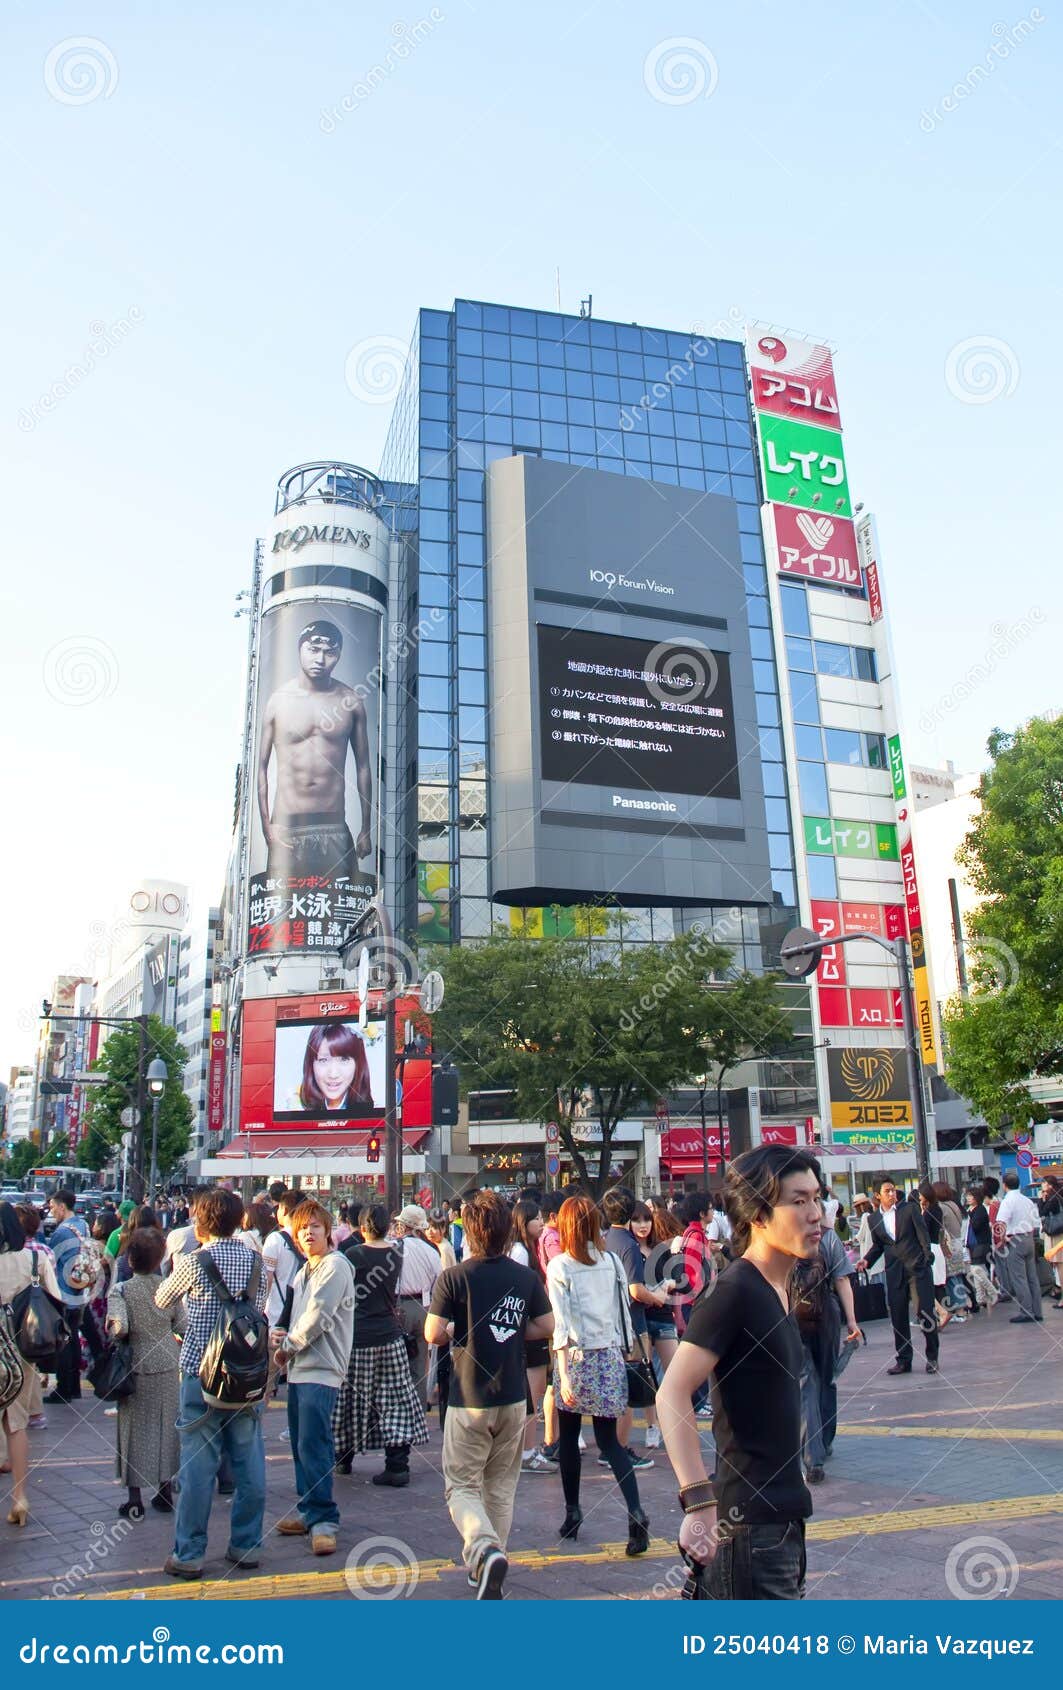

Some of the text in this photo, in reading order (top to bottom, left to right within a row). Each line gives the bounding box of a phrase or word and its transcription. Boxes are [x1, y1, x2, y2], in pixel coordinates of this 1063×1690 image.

[761, 374, 838, 413] アコム
[766, 440, 844, 485] レイク
[780, 546, 857, 581] アイフル
[589, 569, 674, 594] 109 Forum Vision
[891, 745, 904, 784] レイク
[612, 795, 677, 812] Panasonic
[816, 826, 870, 849] レイク
[903, 853, 916, 895] アコム
[250, 893, 332, 925] 世界 水泳
[818, 918, 840, 980] アコム
[319, 1001, 348, 1016] Glico
[860, 1008, 882, 1022] 入口
[920, 1000, 933, 1051] プロミス
[849, 1106, 909, 1124] プロミス
